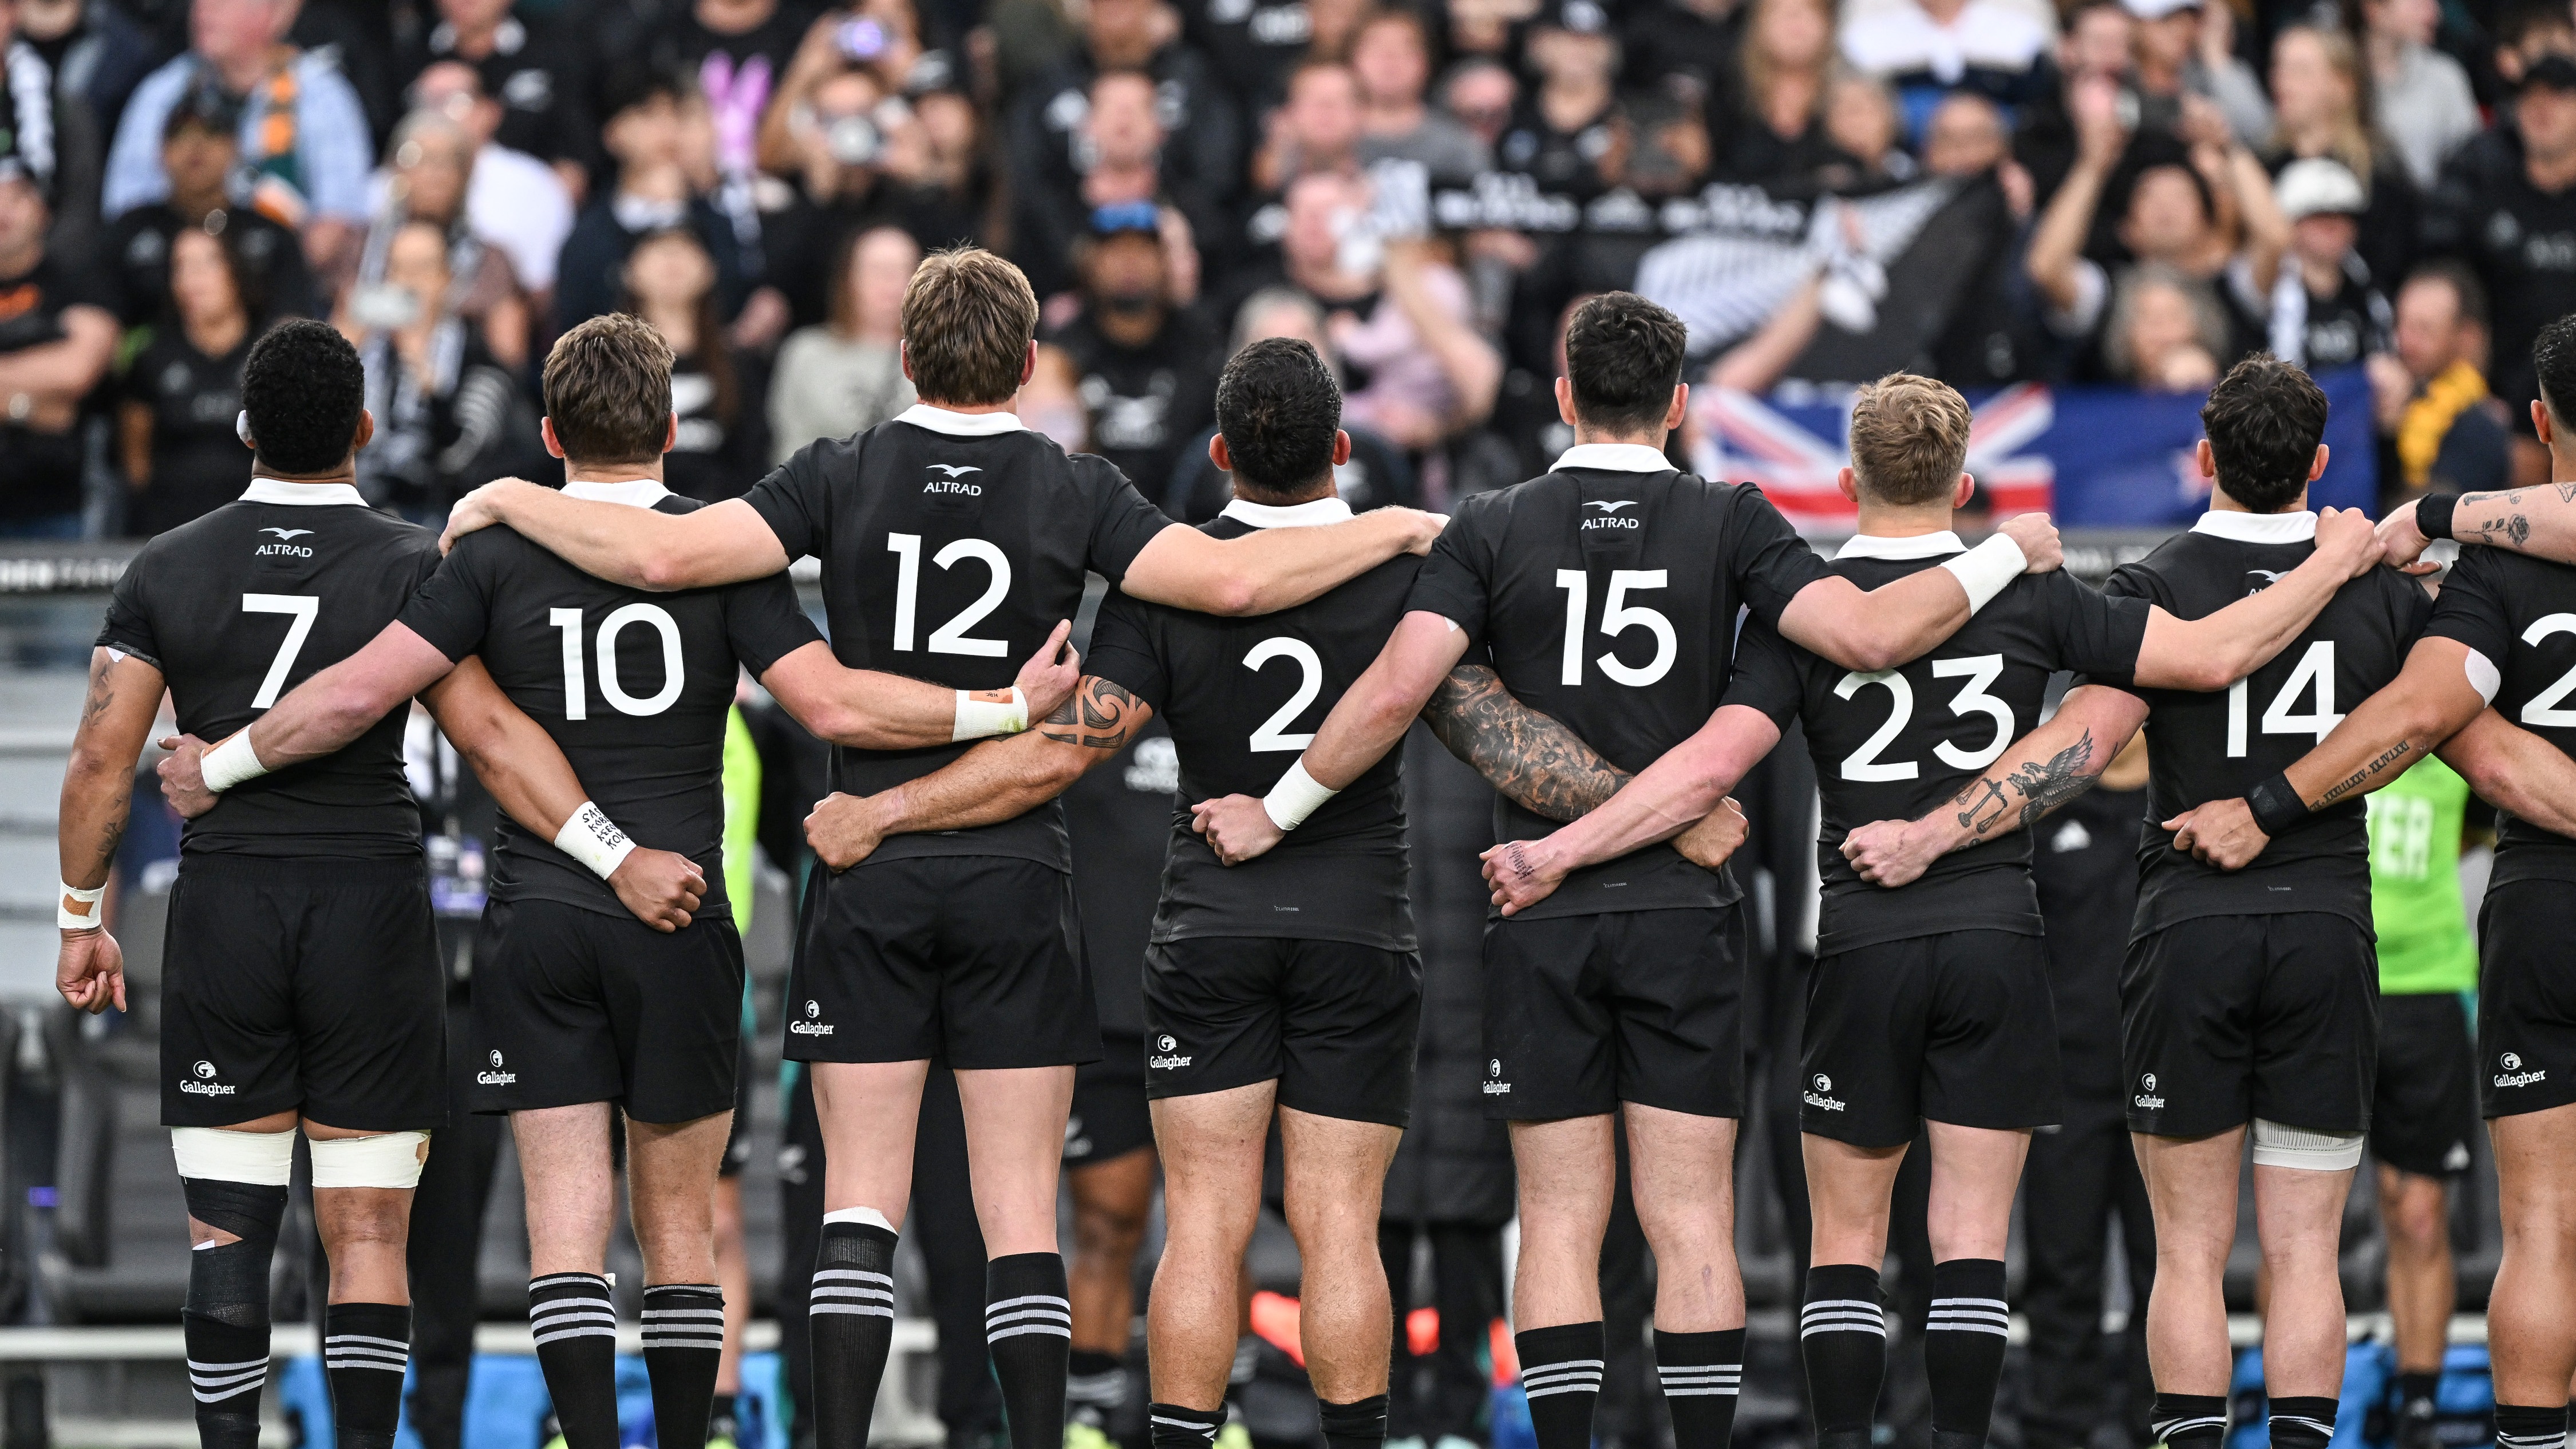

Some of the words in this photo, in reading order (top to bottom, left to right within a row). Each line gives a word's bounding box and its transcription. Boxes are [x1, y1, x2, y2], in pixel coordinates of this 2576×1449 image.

[923, 481, 982, 496] ALTRAD
[1581, 517, 1639, 530] ALTRAD
[255, 544, 313, 558] ALTRAD
[888, 532, 1011, 657] 12
[1556, 568, 1677, 686] 15
[242, 593, 319, 709] 7
[550, 603, 685, 720] 10
[1242, 637, 1322, 752] 2
[2227, 640, 2346, 757] 14
[1833, 653, 2015, 782] 23
[791, 1021, 834, 1037] Gallagher
[1151, 1055, 1192, 1070] Gallagher
[477, 1071, 516, 1086] Gallagher
[2494, 1070, 2546, 1087] Gallagher
[180, 1080, 235, 1097] Gallagher
[1483, 1080, 1511, 1096] Gallagher
[1804, 1090, 1846, 1111] Gallagher
[2135, 1094, 2165, 1110] Gallagher
